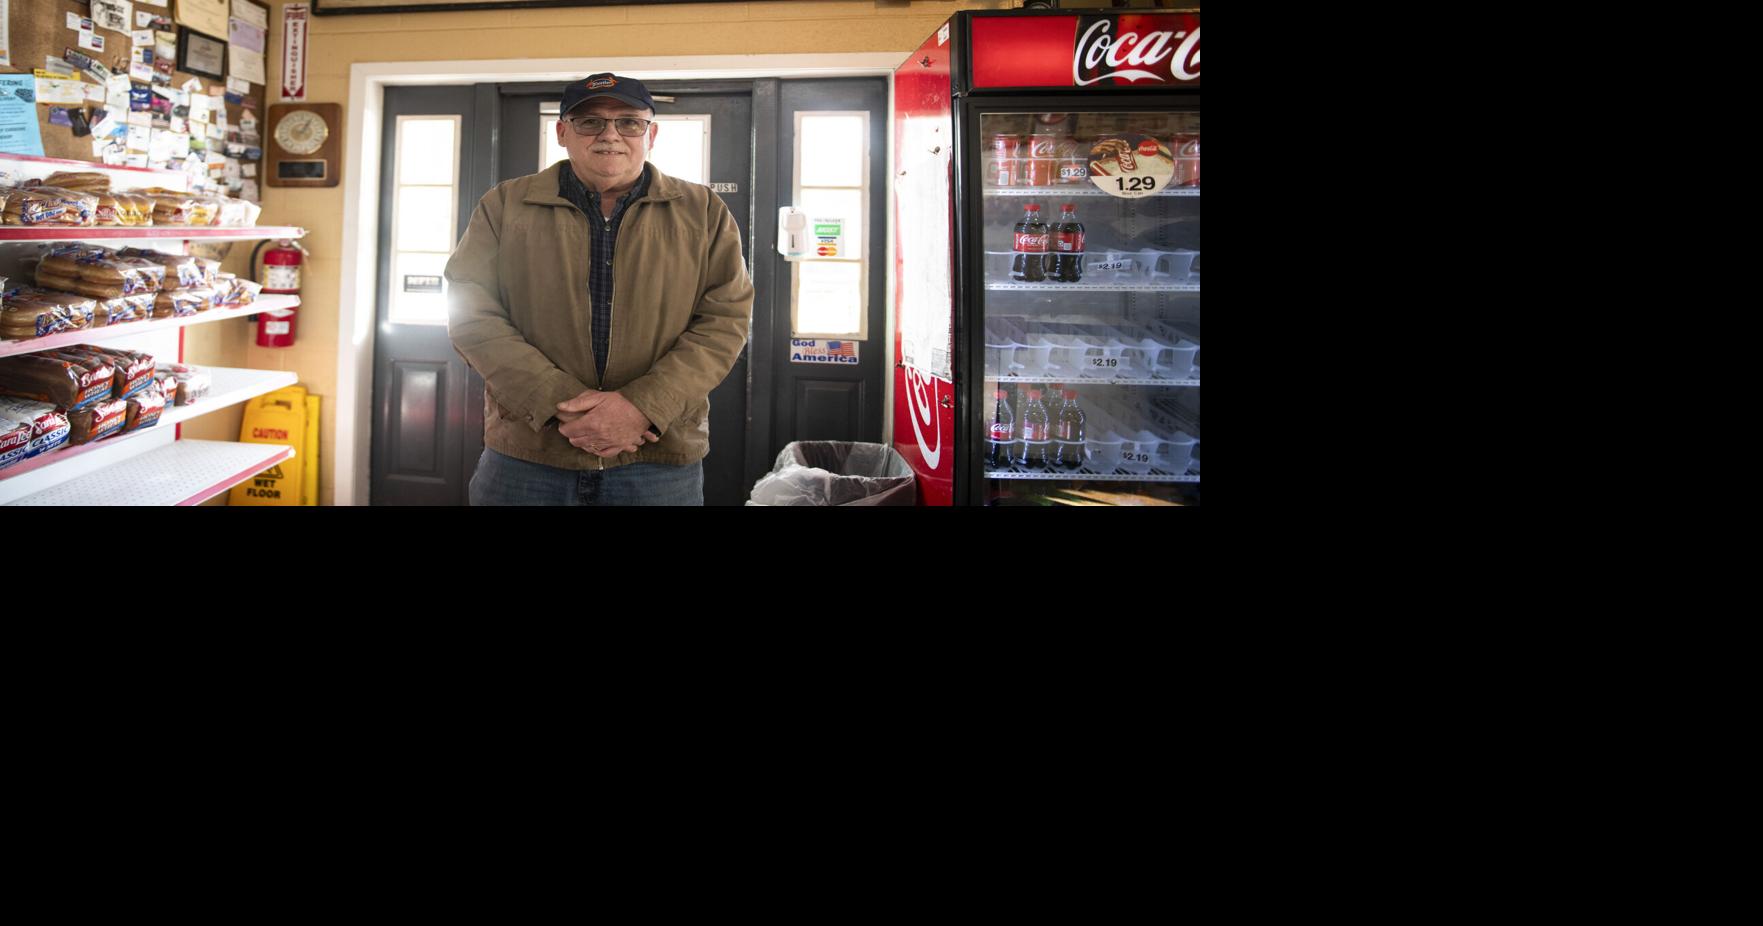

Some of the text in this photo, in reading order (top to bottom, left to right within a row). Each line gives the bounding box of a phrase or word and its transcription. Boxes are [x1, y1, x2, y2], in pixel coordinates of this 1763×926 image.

[285, 12, 305, 20] FIRE
[290, 21, 298, 92] EXTINGUISHER
[1061, 168, 1086, 177] $1.29
[710, 183, 736, 191] PUSH
[1116, 176, 1155, 191] 1.29
[1097, 262, 1122, 270] $2.19
[792, 339, 816, 347] God
[792, 352, 858, 363] America
[1092, 358, 1117, 367] $2.19
[252, 428, 289, 439] CAUTION
[0, 446, 28, 461] ASSIC
[1123, 451, 1148, 462] $2.19
[254, 479, 276, 488] WET
[246, 488, 281, 499] FLOOR
